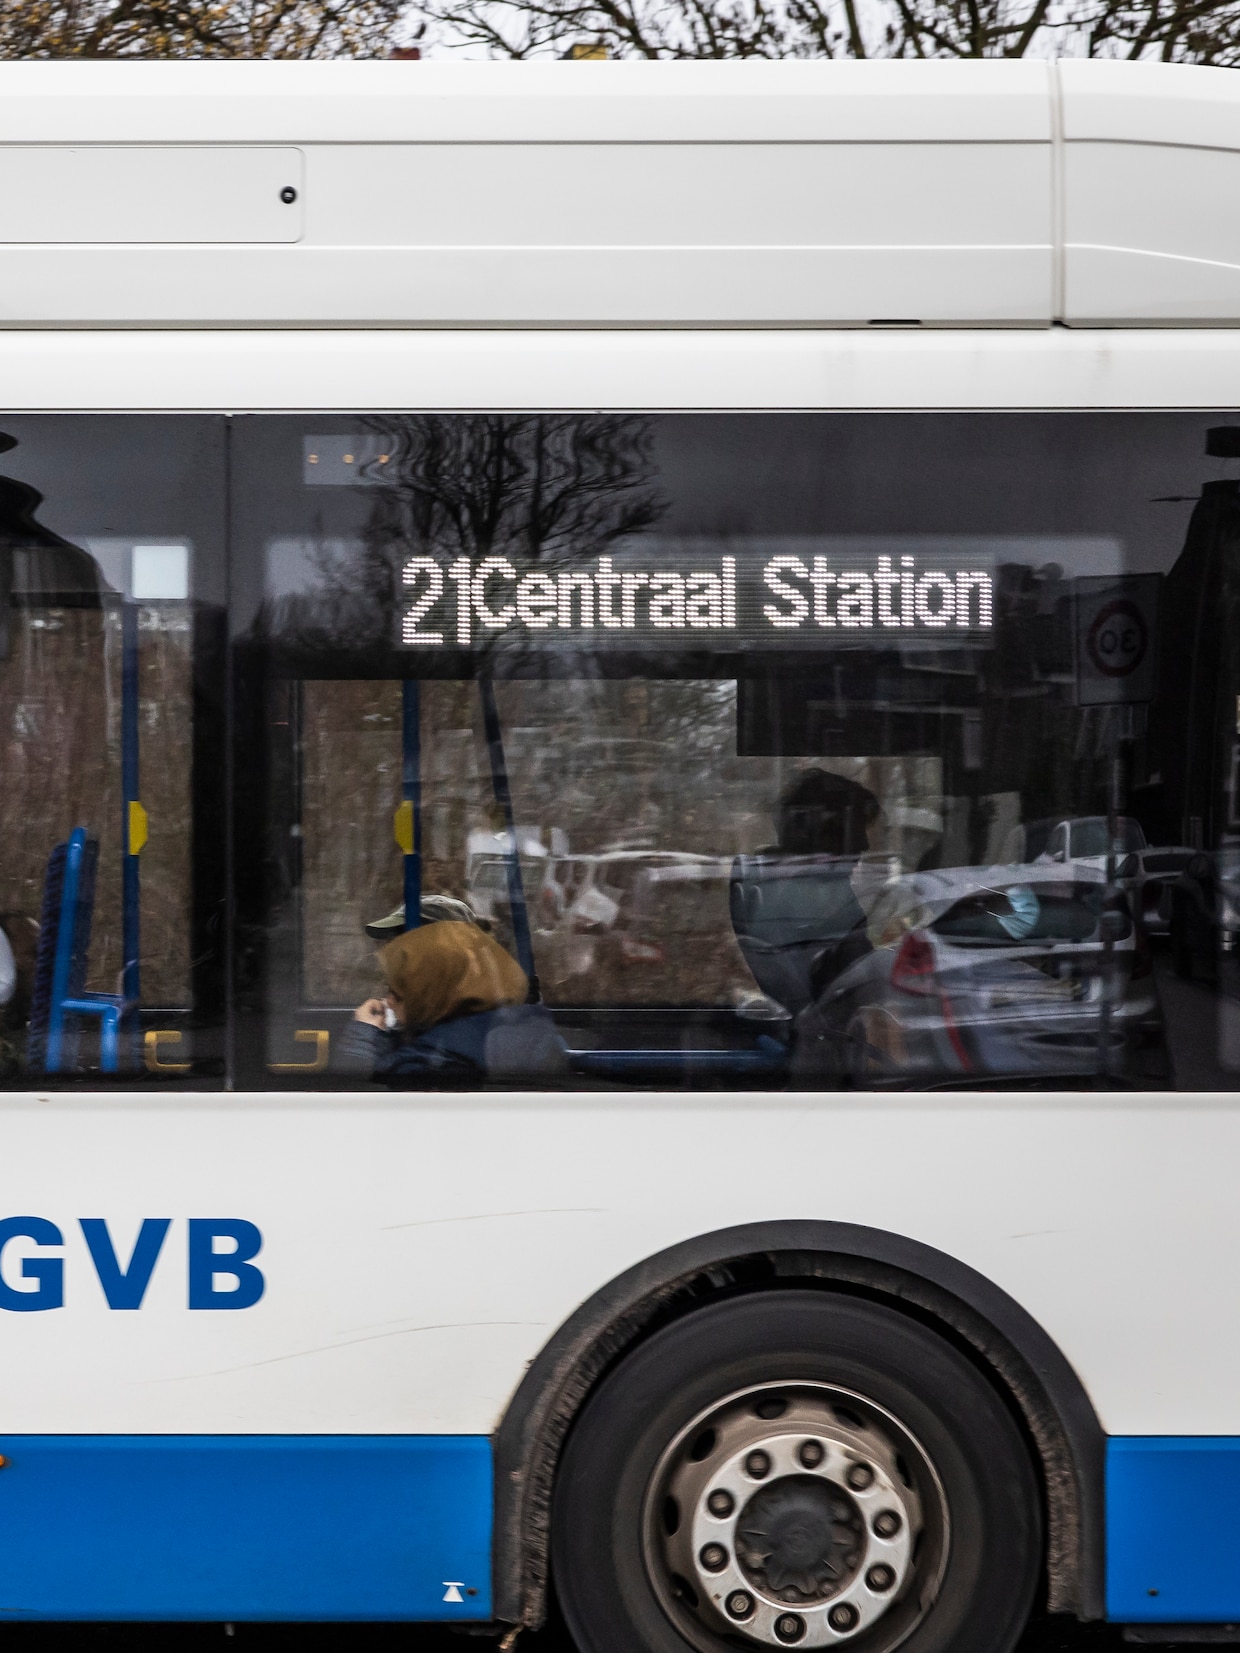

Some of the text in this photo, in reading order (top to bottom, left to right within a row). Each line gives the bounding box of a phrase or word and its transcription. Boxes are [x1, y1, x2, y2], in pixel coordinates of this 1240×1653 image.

[402, 555, 994, 644] 21 Centraal Station
